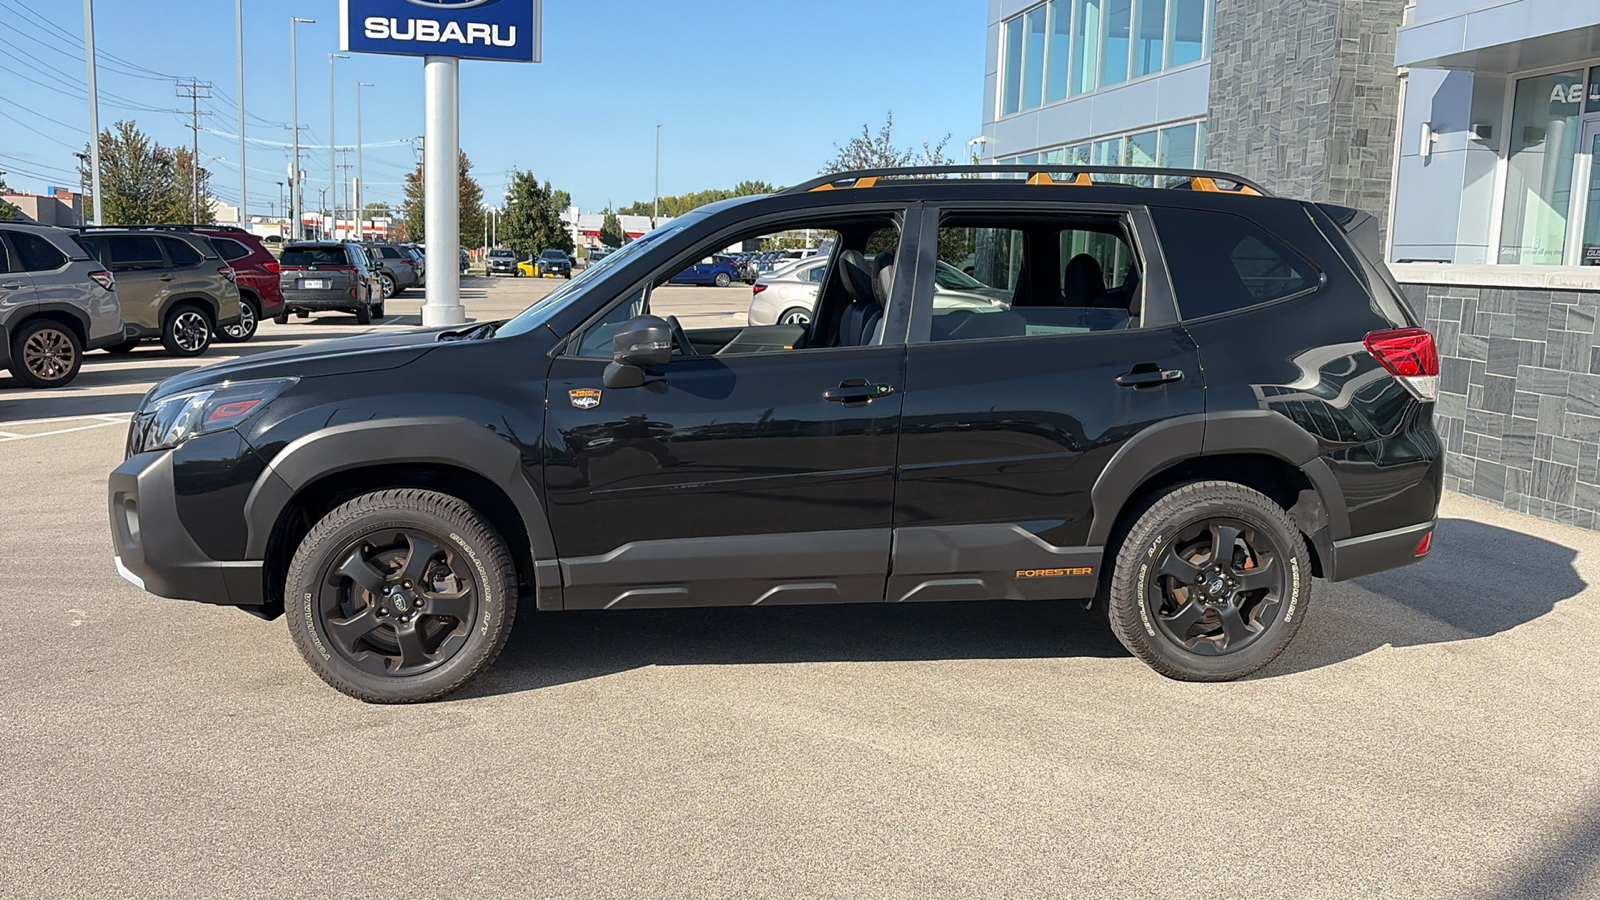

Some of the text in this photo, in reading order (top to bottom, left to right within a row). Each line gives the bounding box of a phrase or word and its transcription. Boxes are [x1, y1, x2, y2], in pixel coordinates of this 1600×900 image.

[364, 17, 517, 47] SUBARU
[449, 532, 492, 603] GEOLANDAR
[1016, 567, 1092, 578] FORESTER
[1137, 534, 1163, 637] GEOLANDAR A/T
[1284, 557, 1300, 623] YOKOHAMA
[303, 592, 331, 661] YOKOHAMA
